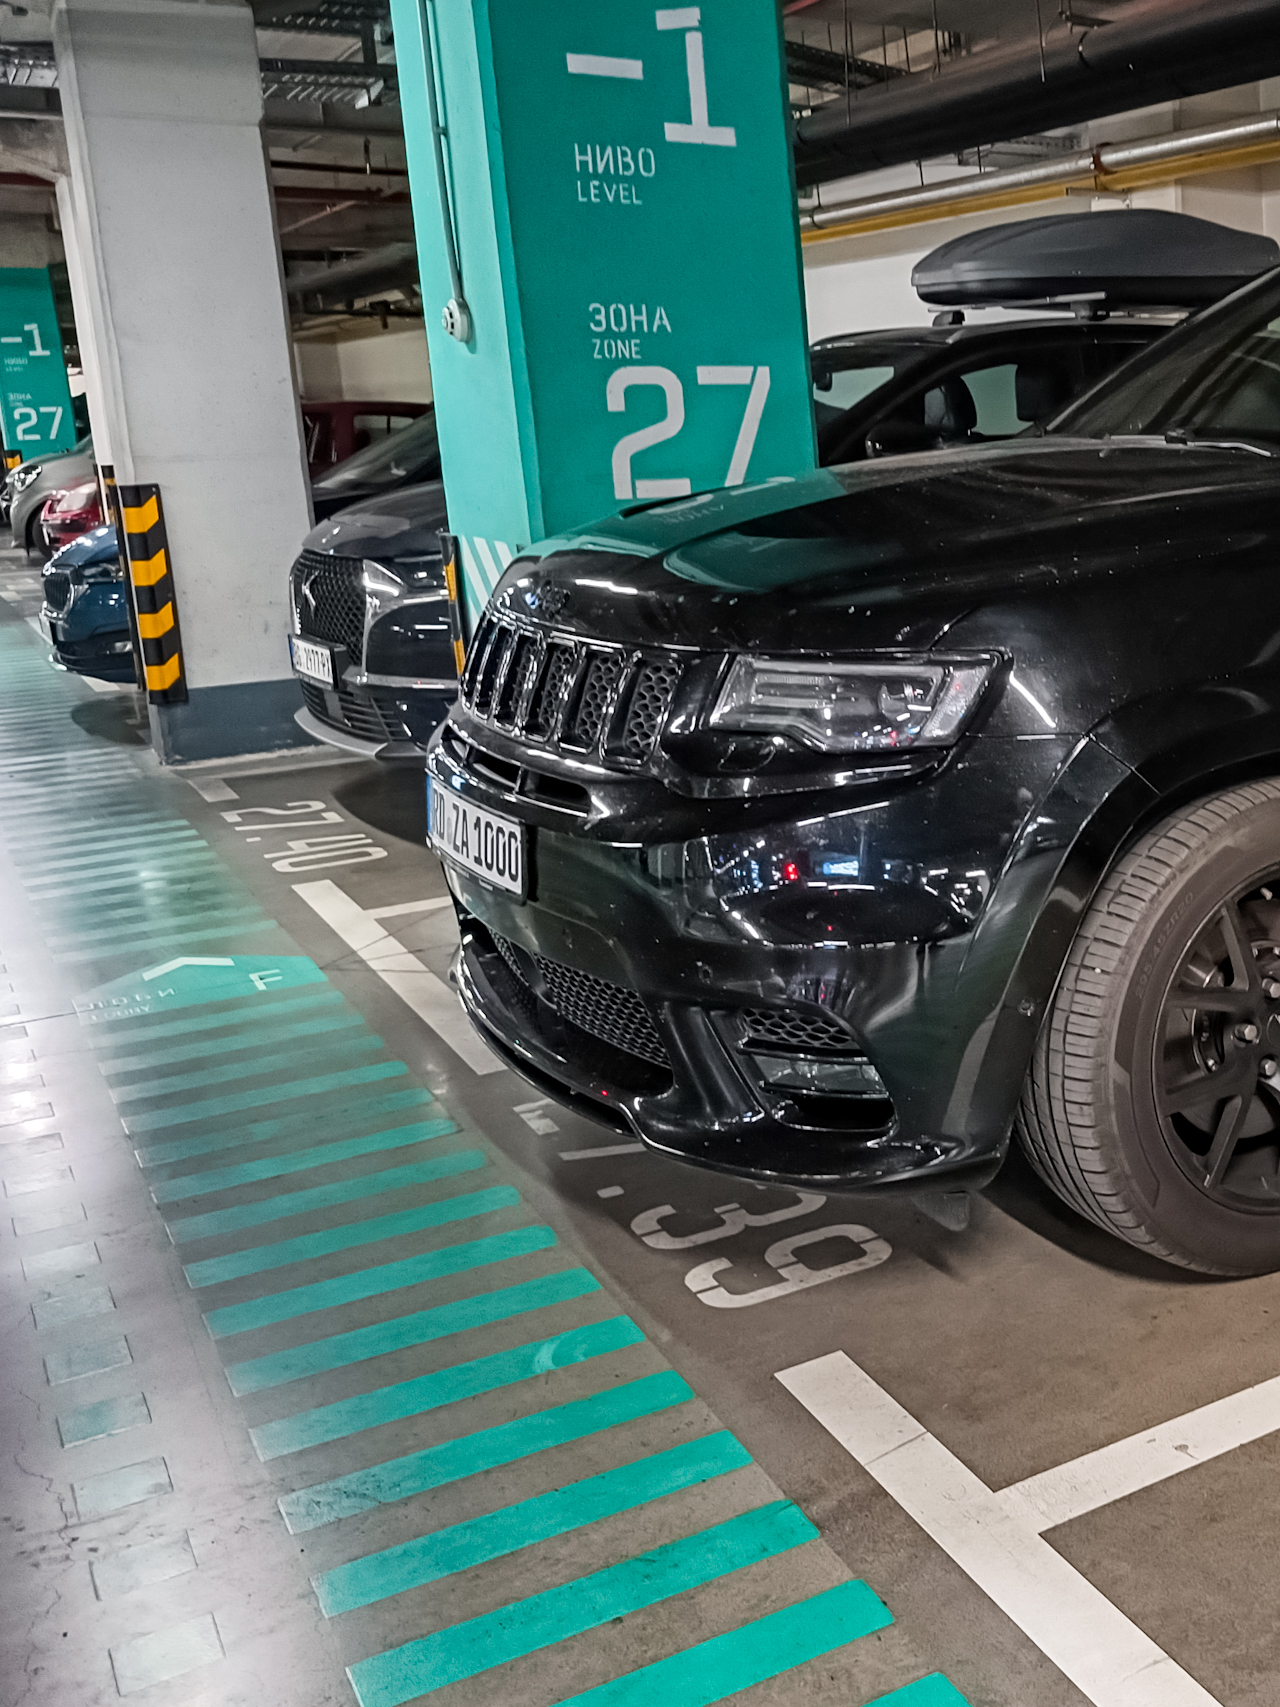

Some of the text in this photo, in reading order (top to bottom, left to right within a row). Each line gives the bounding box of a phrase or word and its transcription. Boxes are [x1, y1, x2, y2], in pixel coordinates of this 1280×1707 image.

[566, 7, 737, 147] -1
[574, 143, 656, 177] НИВО
[577, 180, 643, 205] LEVEL
[588, 303, 672, 333] ЗОНА
[0, 324, 51, 356] -1
[592, 338, 642, 359] ZONE
[13, 405, 63, 441] 27
[606, 366, 770, 500] 27
[220, 800, 388, 873] 27.40
[473, 815, 520, 883] 1000
[512, 1098, 893, 1309] .39
